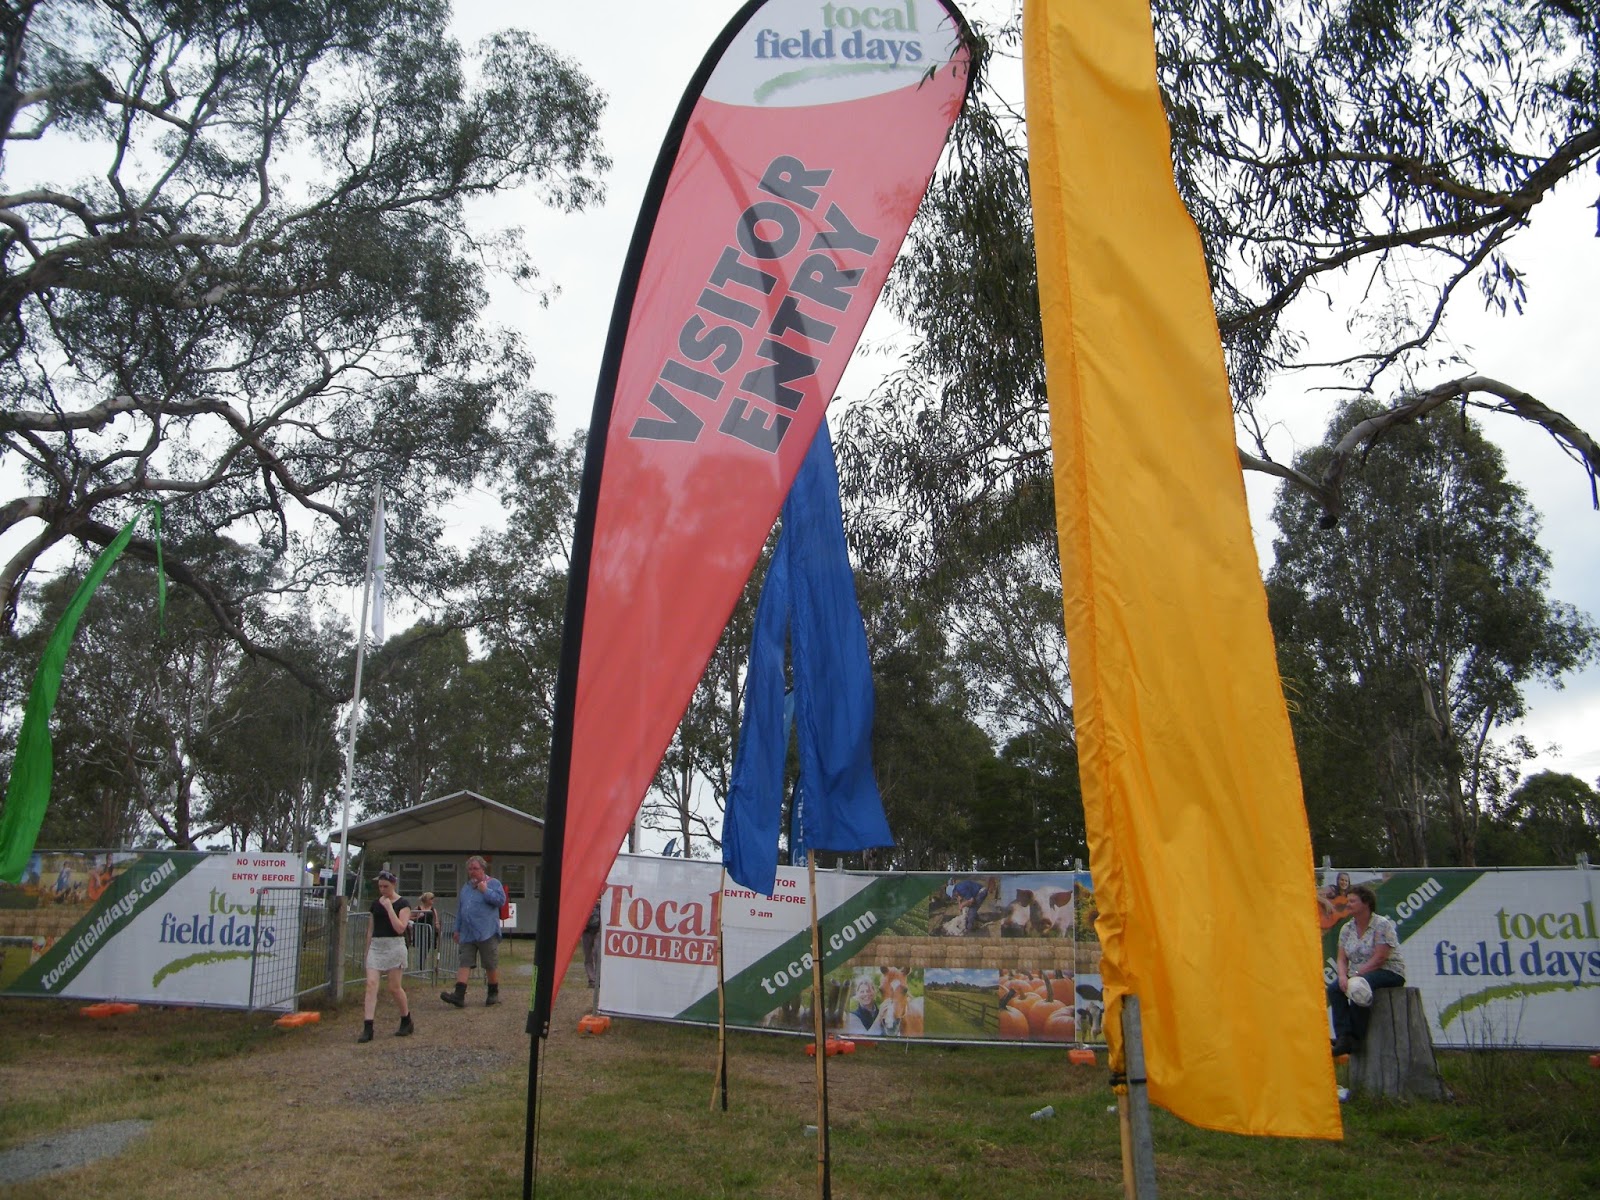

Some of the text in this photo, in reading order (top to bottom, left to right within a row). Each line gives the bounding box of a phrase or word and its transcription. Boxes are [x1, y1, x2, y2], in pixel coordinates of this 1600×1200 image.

[821, 0, 918, 32] tocal
[754, 28, 923, 69] field days
[628, 154, 834, 443] VISITOR
[717, 200, 880, 454] ENTRY
[231, 873, 295, 882] ENTRY BEFORE
[236, 858, 286, 868] NO VISITOR
[601, 881, 719, 937] Tocal
[724, 889, 806, 904] ENTRY BEFORE
[750, 908, 773, 918] 9 am
[41, 858, 176, 990] tocalfielddays.com
[159, 912, 215, 945] field
[1494, 900, 1600, 940] tocal
[607, 932, 715, 962] COLLEGE
[761, 910, 878, 995] toca.com
[1434, 940, 1600, 986] field days
